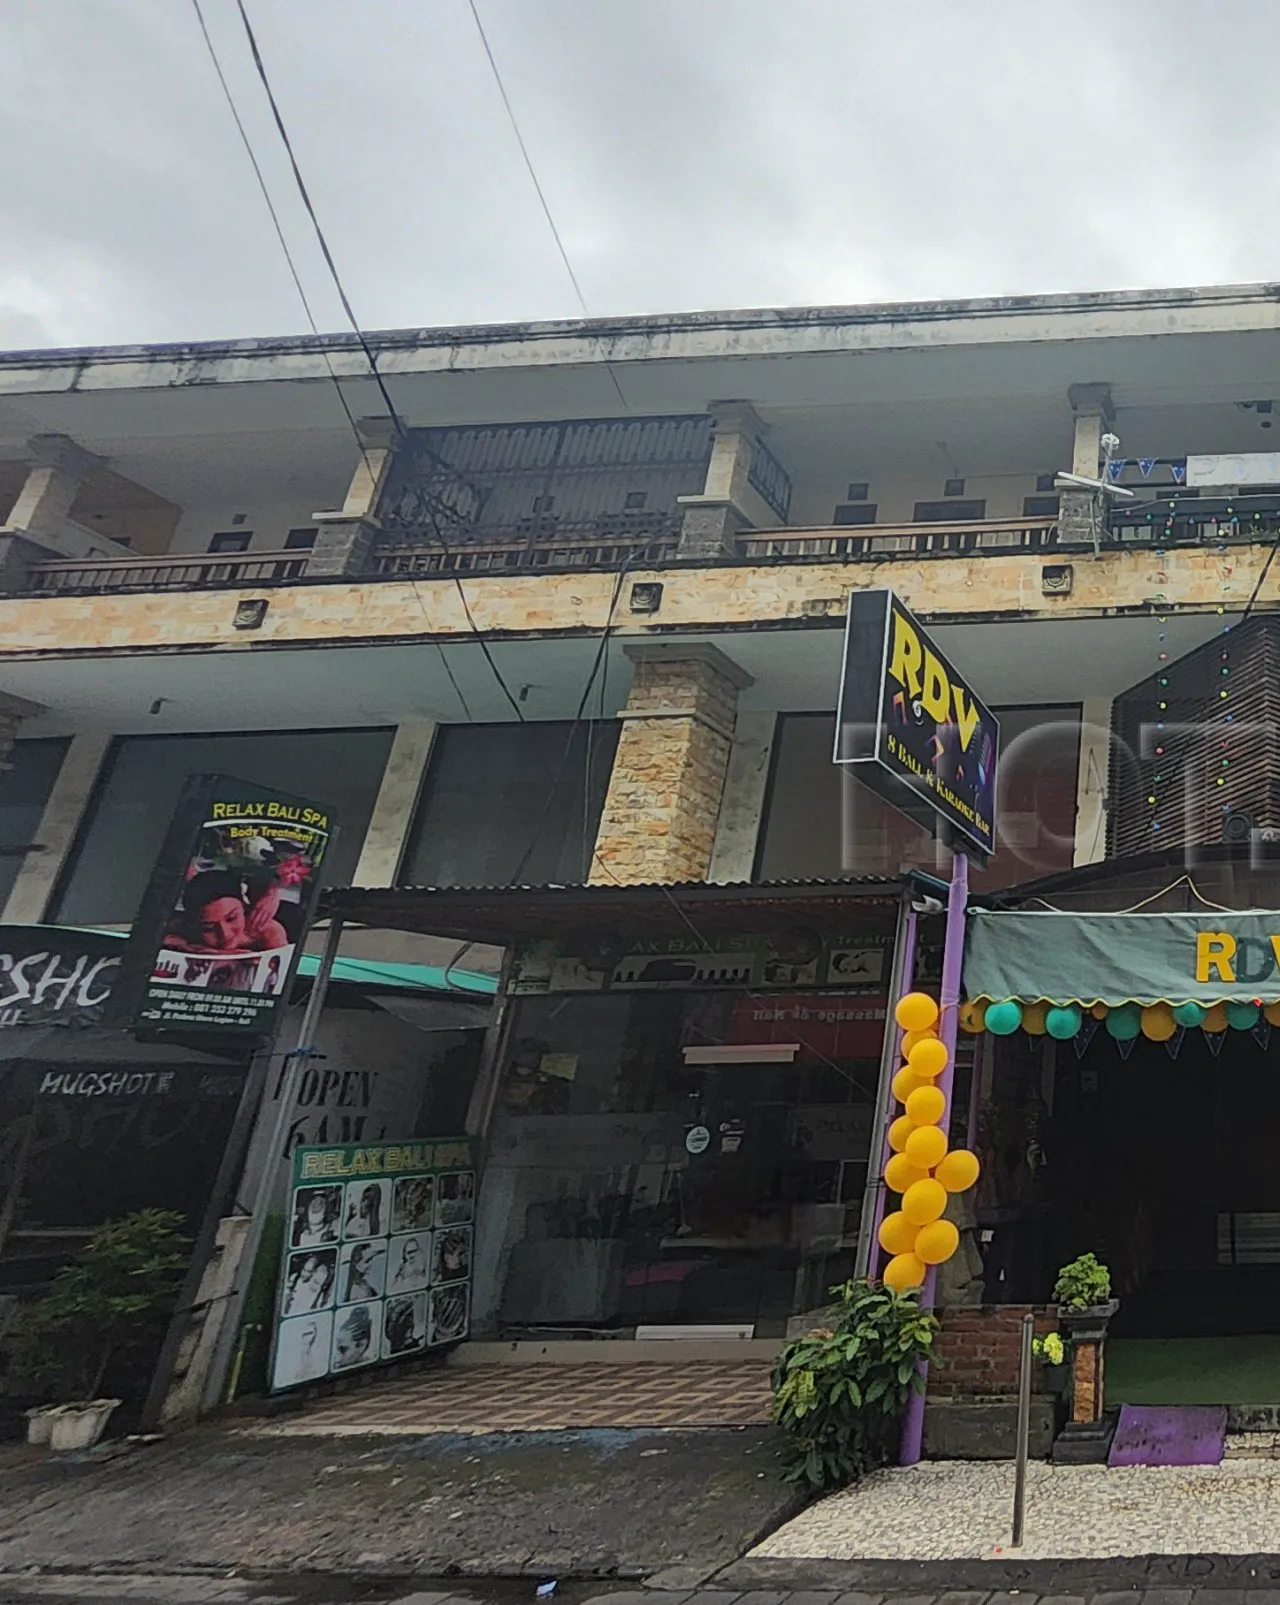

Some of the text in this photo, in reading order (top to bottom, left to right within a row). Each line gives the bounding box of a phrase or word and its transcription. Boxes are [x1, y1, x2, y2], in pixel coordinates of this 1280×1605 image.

[888, 607, 980, 752] RDV
[213, 803, 328, 828] RELAX BALI SPA
[230, 826, 313, 843] Body Treatment
[297, 1069, 380, 1107] OPEN
[301, 1149, 384, 1179] RELAX
